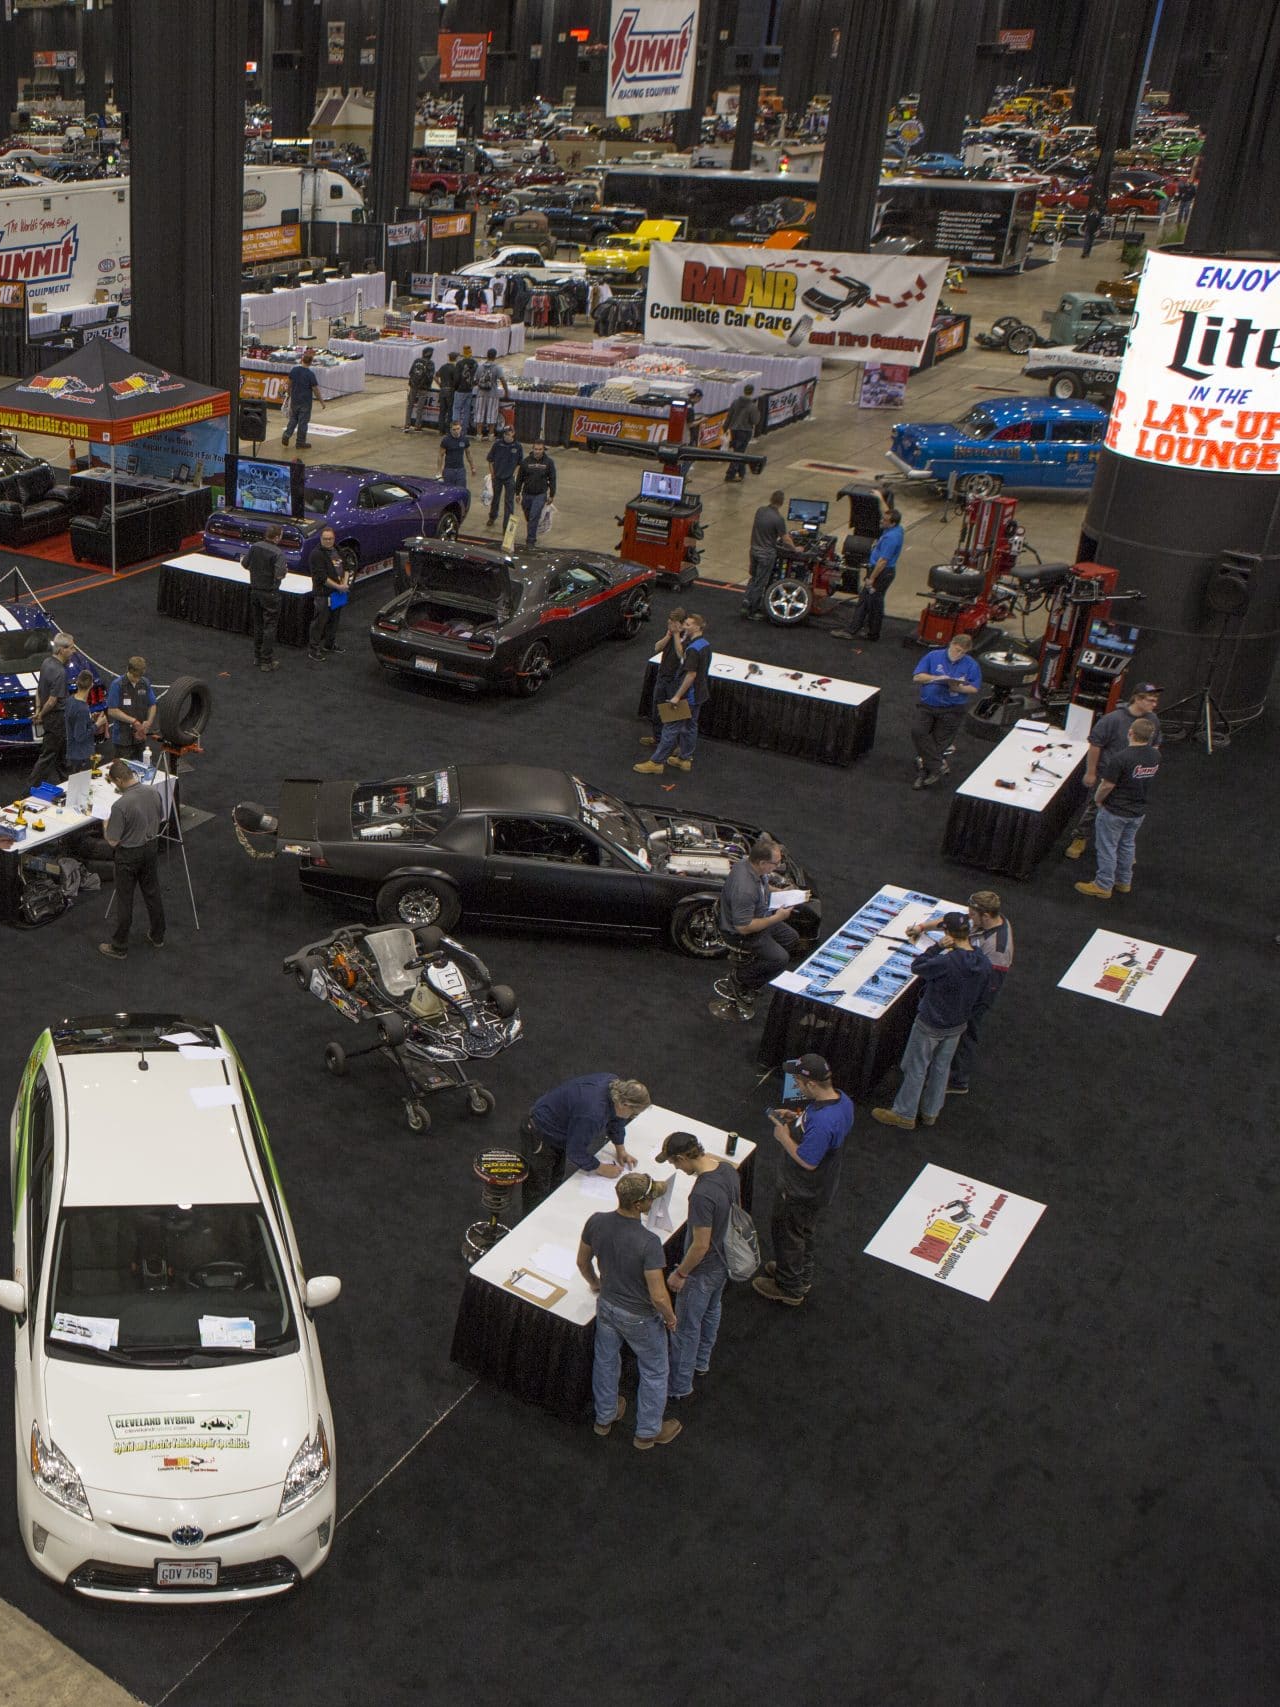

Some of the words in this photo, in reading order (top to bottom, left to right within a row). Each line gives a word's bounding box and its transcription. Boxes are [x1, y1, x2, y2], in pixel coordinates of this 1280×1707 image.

[610, 14, 691, 90] SUMMIT
[618, 87, 643, 99] RACING
[645, 85, 680, 98] EQUIPMENT
[681, 261, 798, 311] RADAIR
[1196, 265, 1280, 292] ENJOY
[27, 283, 70, 298] QUIPMENT
[650, 303, 720, 328] Complete
[724, 309, 751, 328] Car
[754, 311, 792, 331] Care
[1160, 298, 1220, 325] Miller
[808, 331, 836, 346] and
[838, 331, 868, 348] Tire
[1166, 309, 1280, 381] Lite
[1095, 371, 1116, 383] 650
[1189, 385, 1211, 401] IN
[1216, 387, 1252, 405] THE
[574, 414, 622, 437] SUMMIT
[1135, 428, 1280, 472] LOUNGE
[951, 1242, 967, 1254] Car
[115, 1416, 161, 1429] CLEVELAND
[163, 1415, 195, 1425] HYBRID
[186, 1567, 213, 1580] 7685
